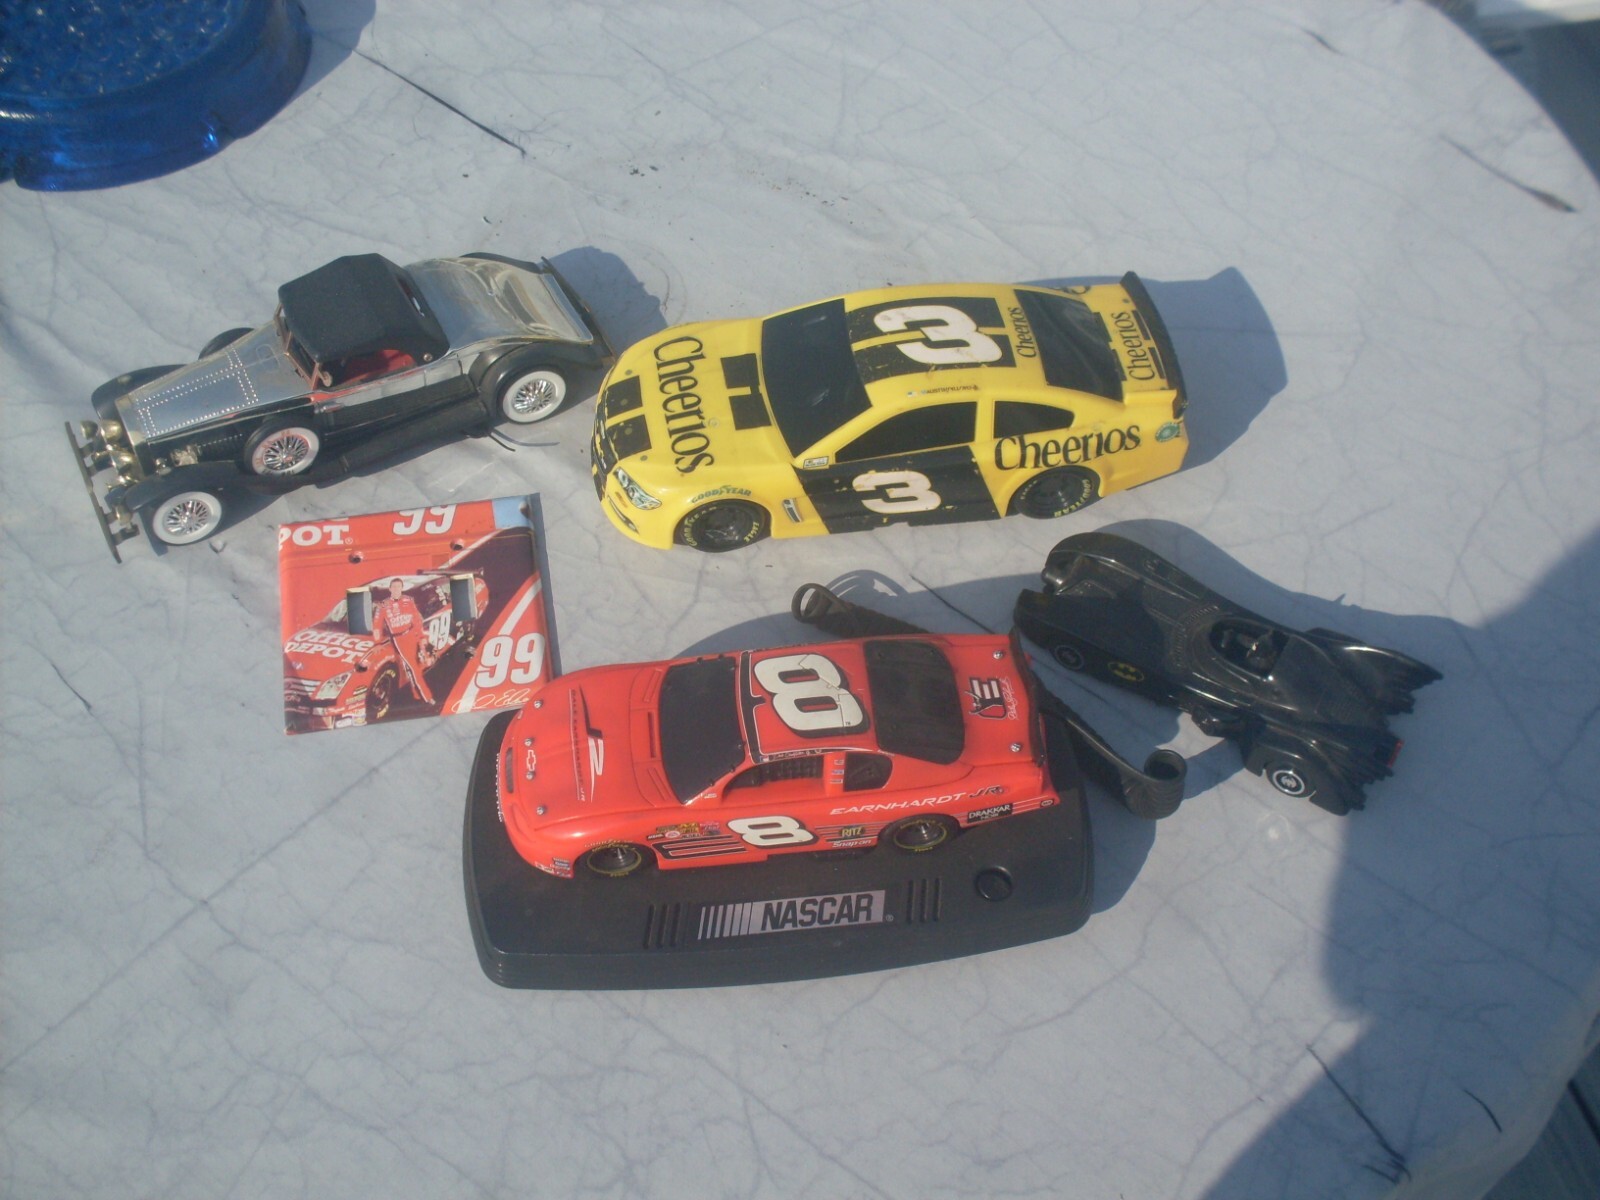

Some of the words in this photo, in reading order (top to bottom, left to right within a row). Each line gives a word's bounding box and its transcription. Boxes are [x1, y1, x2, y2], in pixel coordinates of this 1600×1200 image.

[873, 304, 1003, 365] 3
[1006, 306, 1037, 359] Cheerios
[1110, 311, 1156, 381] Cheerios
[653, 335, 715, 475] Cheerios
[994, 424, 1142, 472] Cheerios
[690, 484, 752, 504] GOODYEAR
[852, 470, 942, 514] 3
[284, 641, 365, 665] DEPOT
[294, 630, 375, 652] Office
[475, 632, 546, 688] 99
[753, 653, 864, 732] 8
[830, 792, 967, 816] EARNHARDT
[968, 804, 1011, 820] DRAKKAR
[727, 815, 815, 847] 8
[841, 826, 863, 838] RITZ
[761, 893, 873, 932] NASCAR
